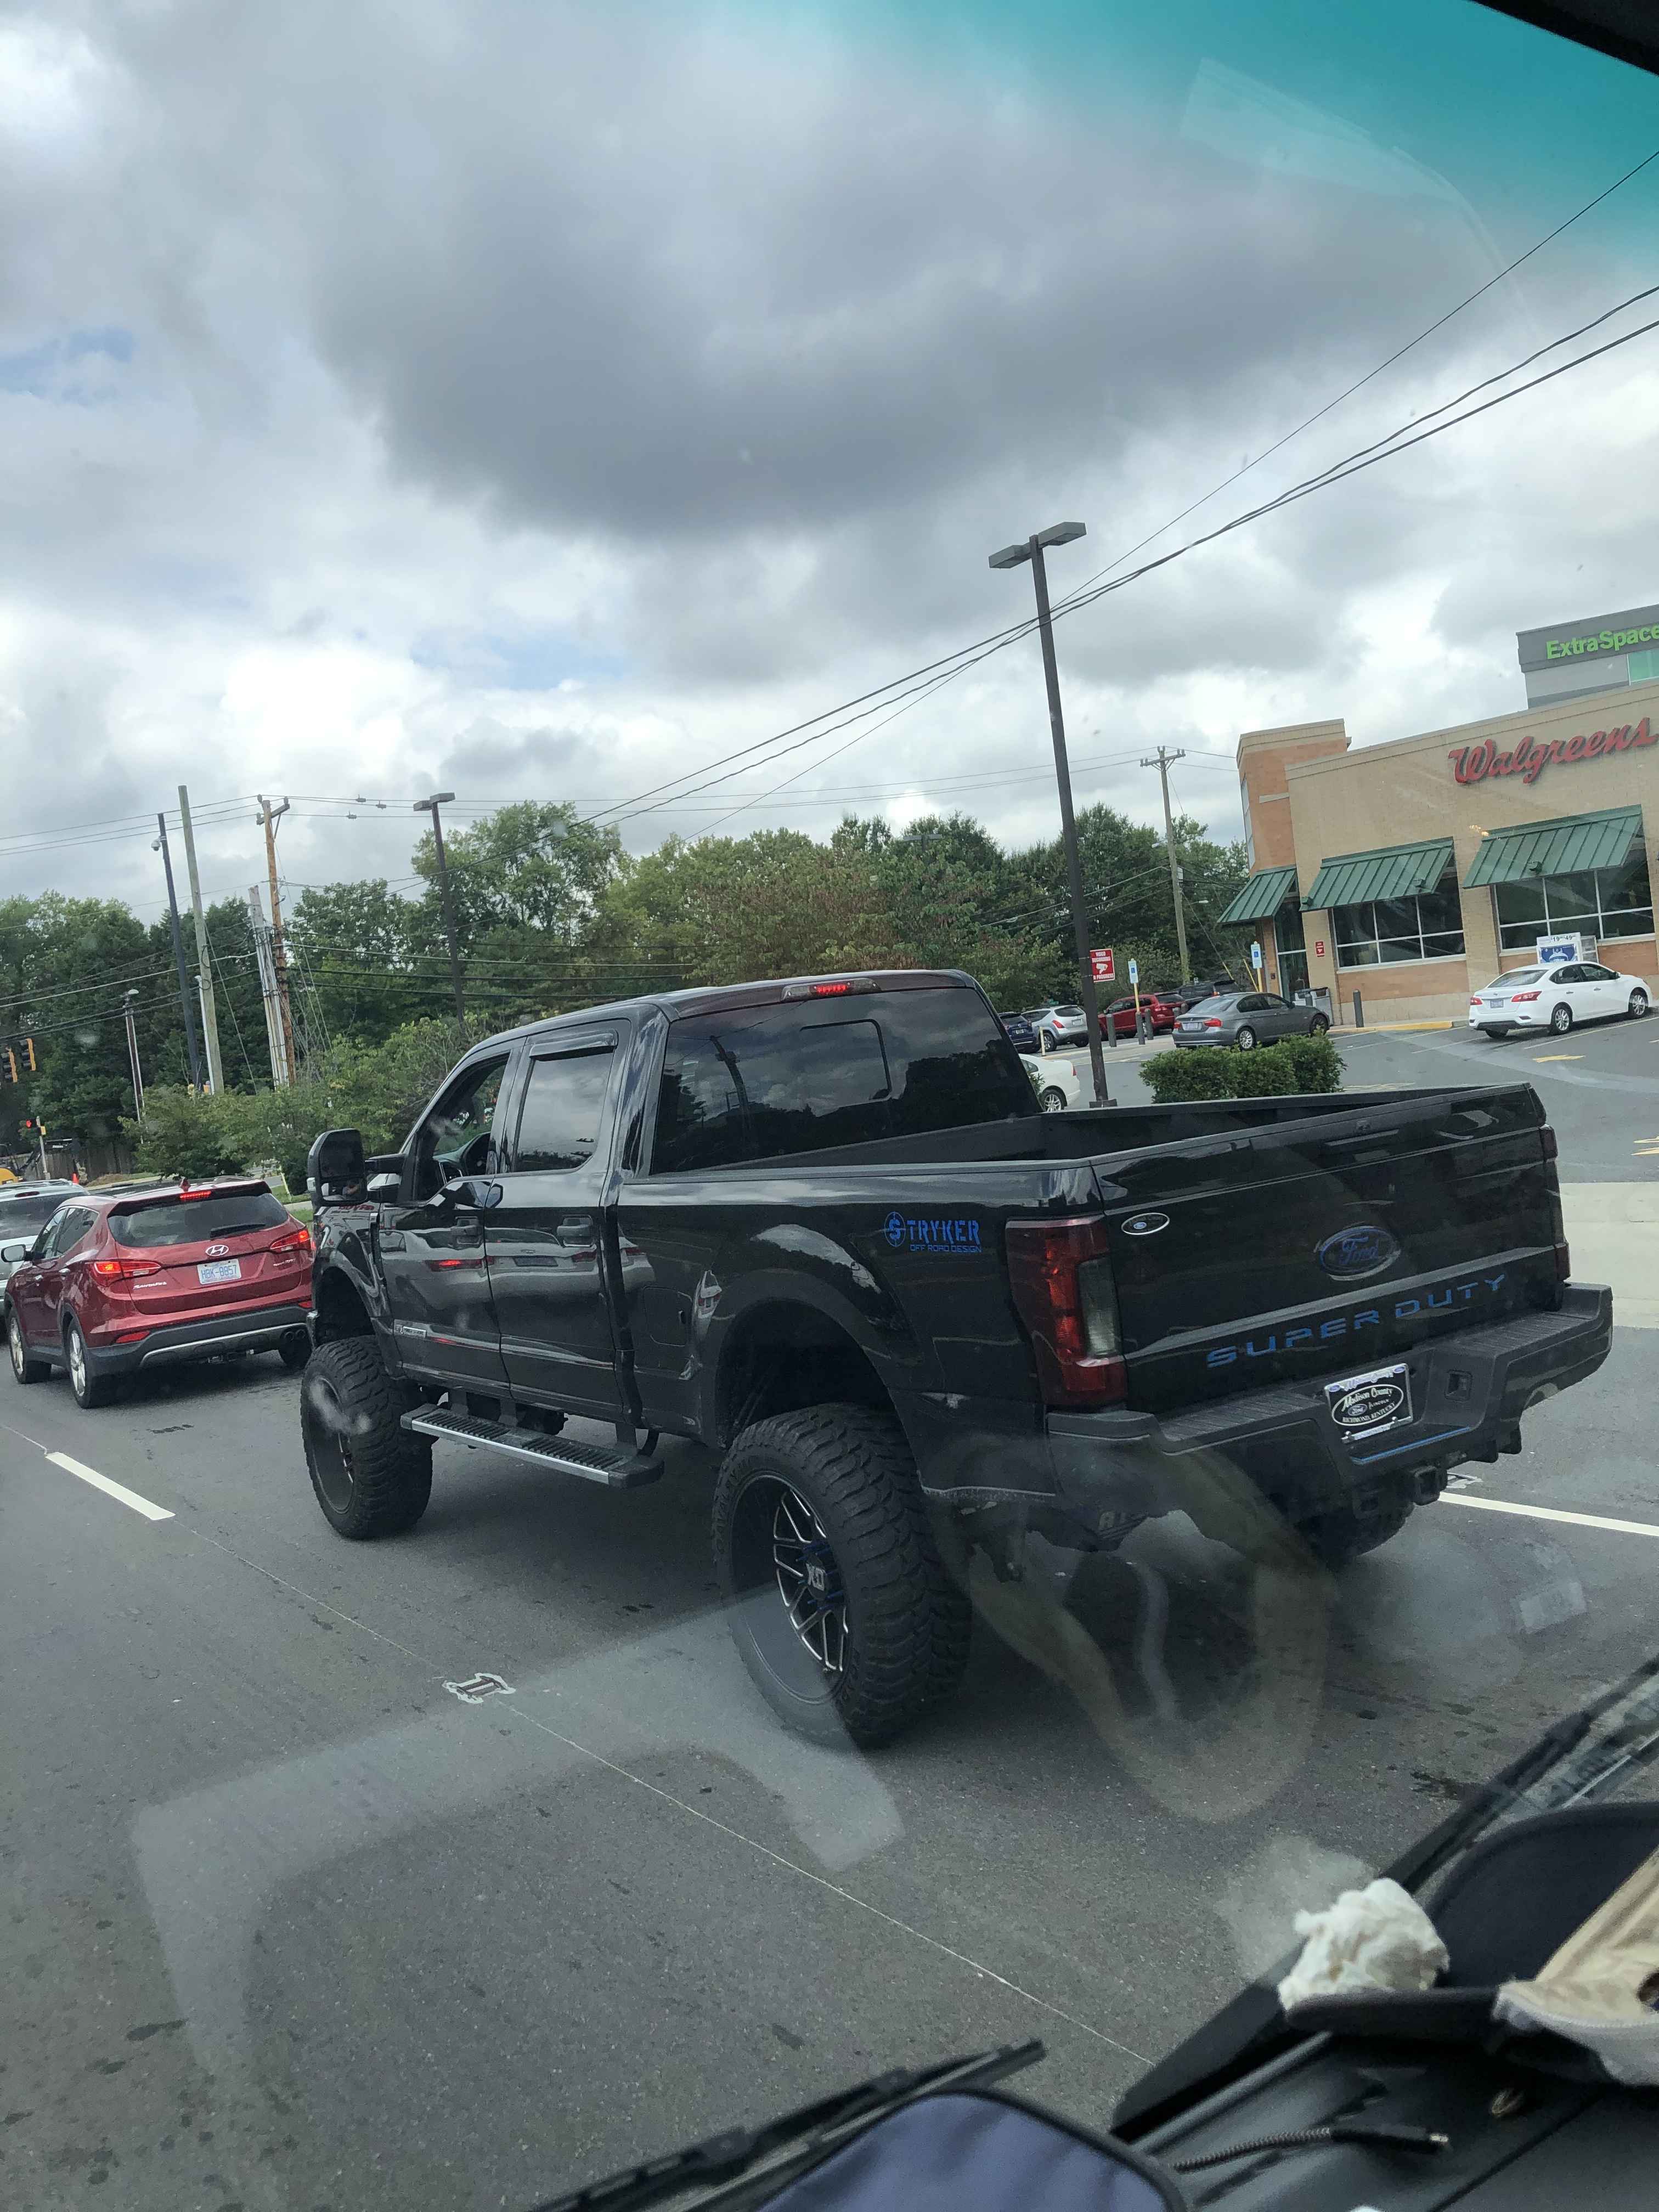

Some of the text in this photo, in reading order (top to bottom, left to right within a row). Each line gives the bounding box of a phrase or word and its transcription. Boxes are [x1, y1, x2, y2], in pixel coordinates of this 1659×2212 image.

[1448, 717, 1659, 785] Walgreens
[888, 1219, 981, 1245] STRYKER
[1207, 1274, 1505, 1368] SUPER DUTY
